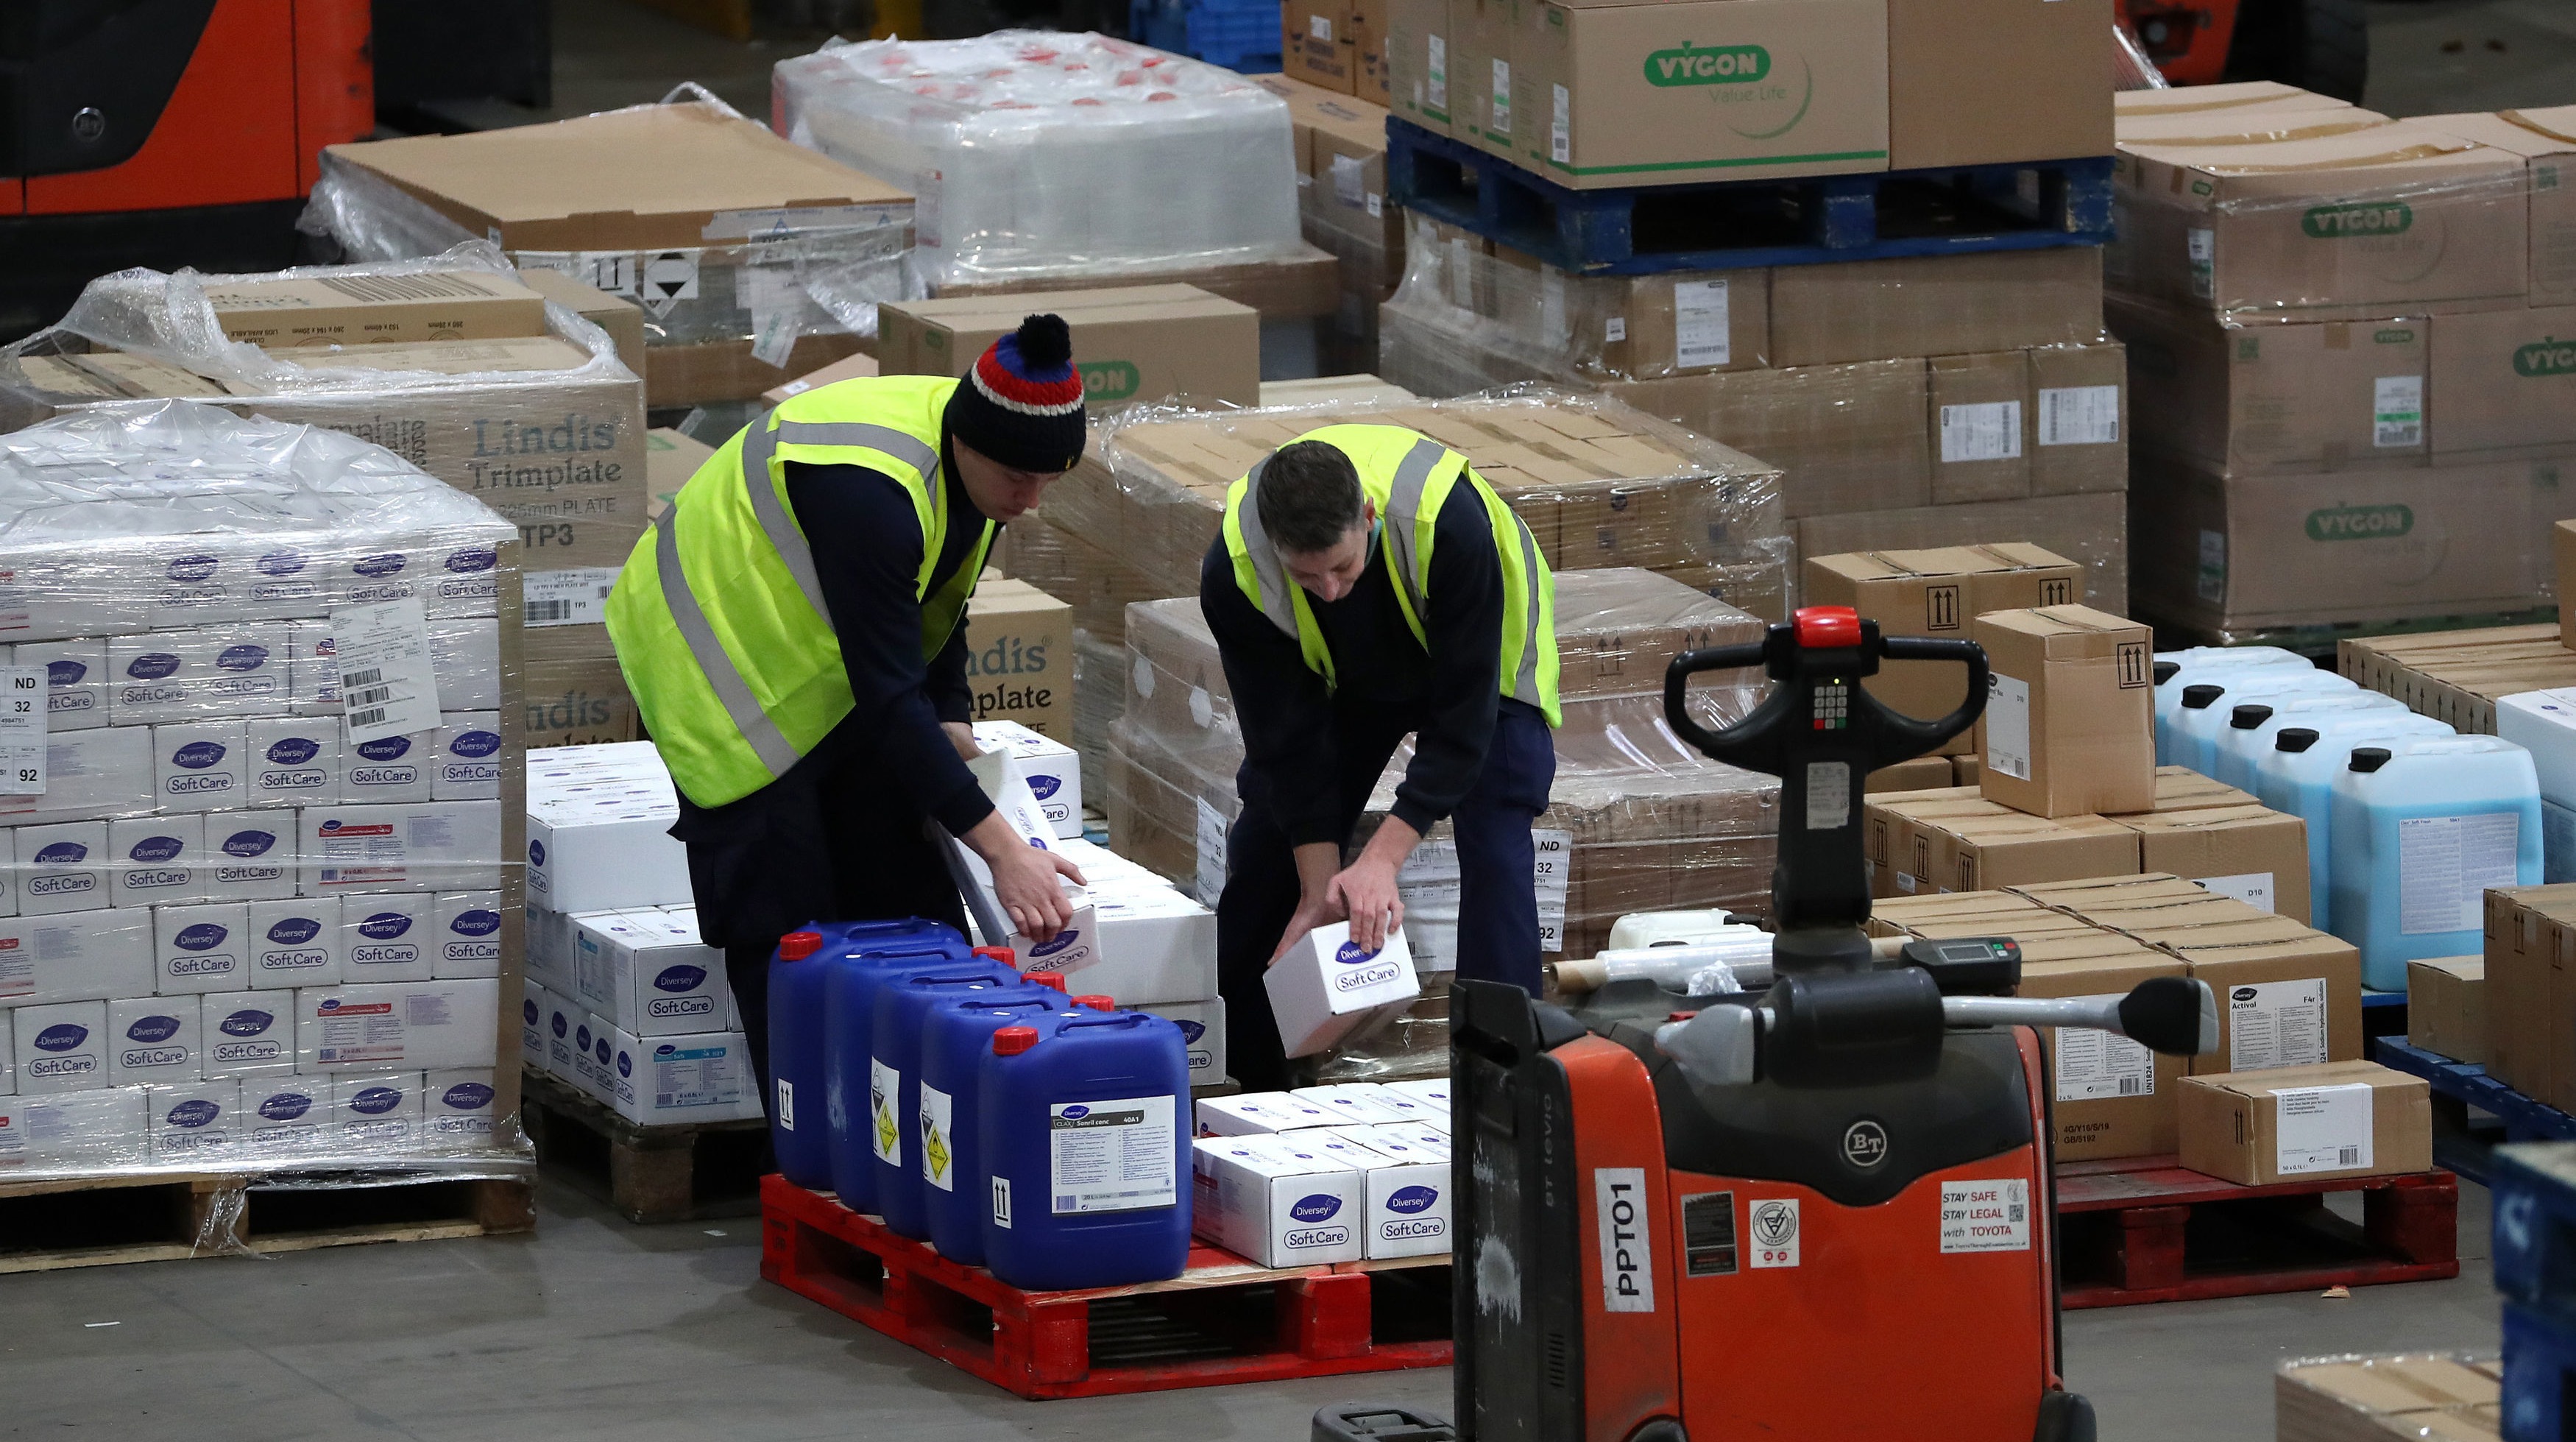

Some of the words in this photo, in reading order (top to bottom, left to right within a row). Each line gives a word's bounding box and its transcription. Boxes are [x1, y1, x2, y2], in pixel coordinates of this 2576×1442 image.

[1657, 52, 1758, 79] VYGON
[1708, 88, 1753, 102] Value
[2315, 211, 2402, 231] VYGON
[2524, 348, 2576, 369] VYG
[473, 412, 617, 458] Lindis
[467, 457, 622, 491] Trimplate
[563, 497, 617, 515] PLATE
[2317, 512, 2404, 534] VYGON
[519, 523, 575, 548] TP3
[380, 585, 408, 598] Care
[134, 663, 167, 676] Diversey
[15, 677, 36, 690] ND
[48, 671, 73, 683] versey
[127, 690, 153, 702] Soft
[155, 689, 183, 701] Care
[969, 683, 1052, 718] plate
[15, 701, 31, 713] 32
[48, 696, 60, 709] ft
[62, 696, 90, 708] Care
[526, 689, 611, 732] ndis
[364, 745, 397, 756] Diversey
[456, 741, 489, 752] Diversey
[179, 752, 213, 763] Diversey
[272, 749, 306, 759] Diversey
[19, 768, 38, 782] 92
[265, 774, 291, 787] Soft
[293, 772, 321, 785] Care
[355, 770, 381, 783] Soft
[383, 768, 412, 782] Care
[449, 767, 475, 780] Soft
[172, 779, 198, 792] Soft
[199, 777, 228, 788] Care
[1042, 807, 1064, 819] are
[136, 847, 170, 858] Diversey
[229, 841, 263, 852] Diversey
[1540, 841, 1560, 851] ND
[222, 867, 247, 880] Soft
[249, 866, 277, 877] Care
[1537, 862, 1552, 874] 32
[34, 880, 60, 894] Soft
[62, 878, 91, 890] Care
[129, 874, 155, 887] Soft
[157, 872, 185, 884] Care
[2248, 888, 2262, 897] D10
[365, 923, 398, 933] Diversey
[457, 920, 490, 930] Diversey
[181, 934, 215, 944] Diversey
[274, 928, 308, 939] Diversey
[1540, 927, 1554, 939] 92
[358, 949, 383, 961] Soft
[385, 947, 414, 960] Care
[449, 945, 475, 958] Soft
[477, 944, 500, 956] Car
[174, 961, 199, 974] Soft
[201, 959, 230, 971] Care
[266, 954, 293, 967] Soft
[294, 953, 322, 965] Care
[1030, 961, 1055, 974] Soft
[1056, 950, 1084, 965] Care
[661, 977, 694, 987] Diversey
[1340, 972, 1367, 989] Soft
[1367, 967, 1395, 981] Care
[654, 1002, 679, 1014] Soft
[680, 1000, 709, 1012] Care
[2232, 1001, 2257, 1010] Actival
[133, 1027, 167, 1037] Diversey
[41, 1036, 75, 1046] Diversey
[127, 1053, 153, 1065] Soft
[155, 1050, 183, 1062] Care
[219, 1046, 245, 1058] Soft
[247, 1045, 276, 1056] Care
[35, 1061, 61, 1074] Soft
[63, 1059, 91, 1071] Care
[1189, 1056, 1207, 1066] are
[2145, 1065, 2154, 1094] UN1824
[449, 1093, 482, 1103] Diversey
[1853, 1134, 1883, 1154] BT
[1393, 1197, 1426, 1208] Diversey
[1943, 1192, 1967, 1204] STAY
[1971, 1191, 1998, 1202] SAFE
[1296, 1205, 1329, 1216] Diversey
[1943, 1210, 1967, 1220] STAY
[1970, 1208, 2003, 1219] LEGAL
[1385, 1223, 1411, 1237] Soft
[1412, 1222, 1440, 1234] Care
[1944, 1228, 1965, 1237] with
[1970, 1225, 2012, 1237] TOYOTA
[1289, 1233, 1314, 1246] Soft
[1316, 1231, 1344, 1243] Care
